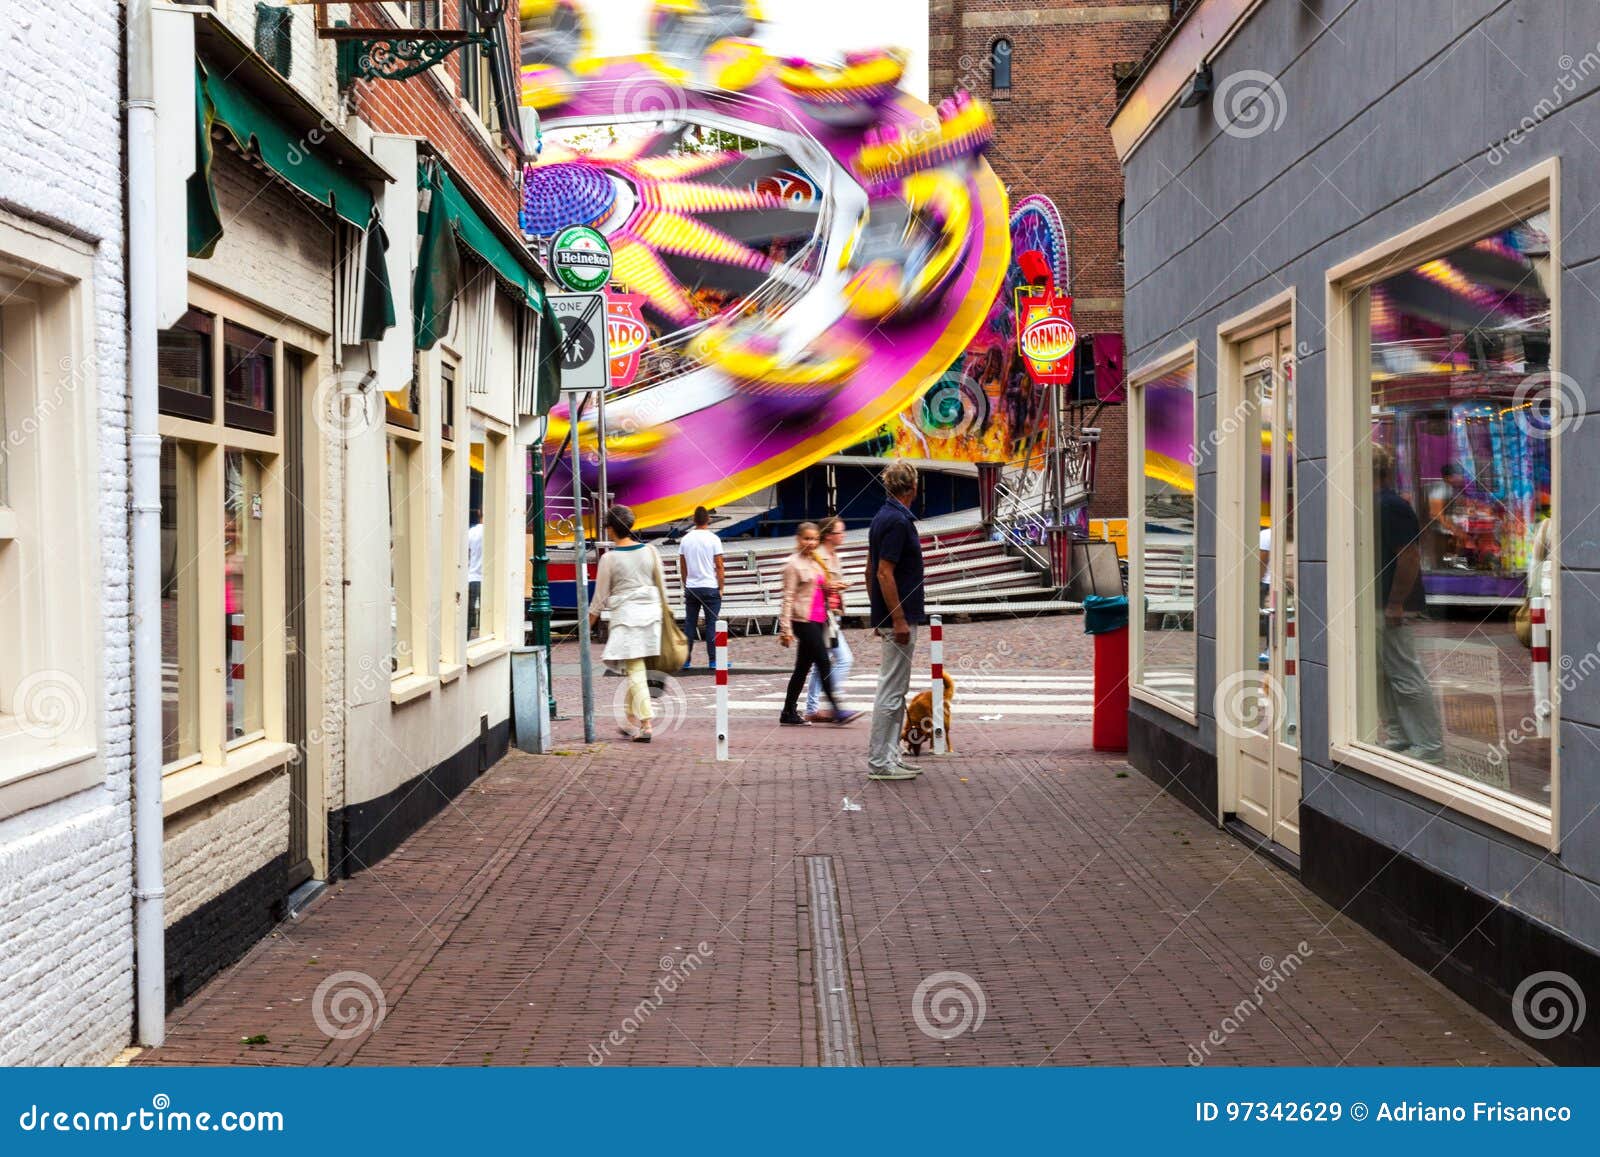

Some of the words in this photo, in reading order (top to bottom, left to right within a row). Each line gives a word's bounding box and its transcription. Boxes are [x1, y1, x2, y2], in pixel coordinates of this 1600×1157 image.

[561, 253, 609, 265] Heineken
[552, 302, 583, 313] ZONE
[1025, 325, 1074, 351] TORNADO
